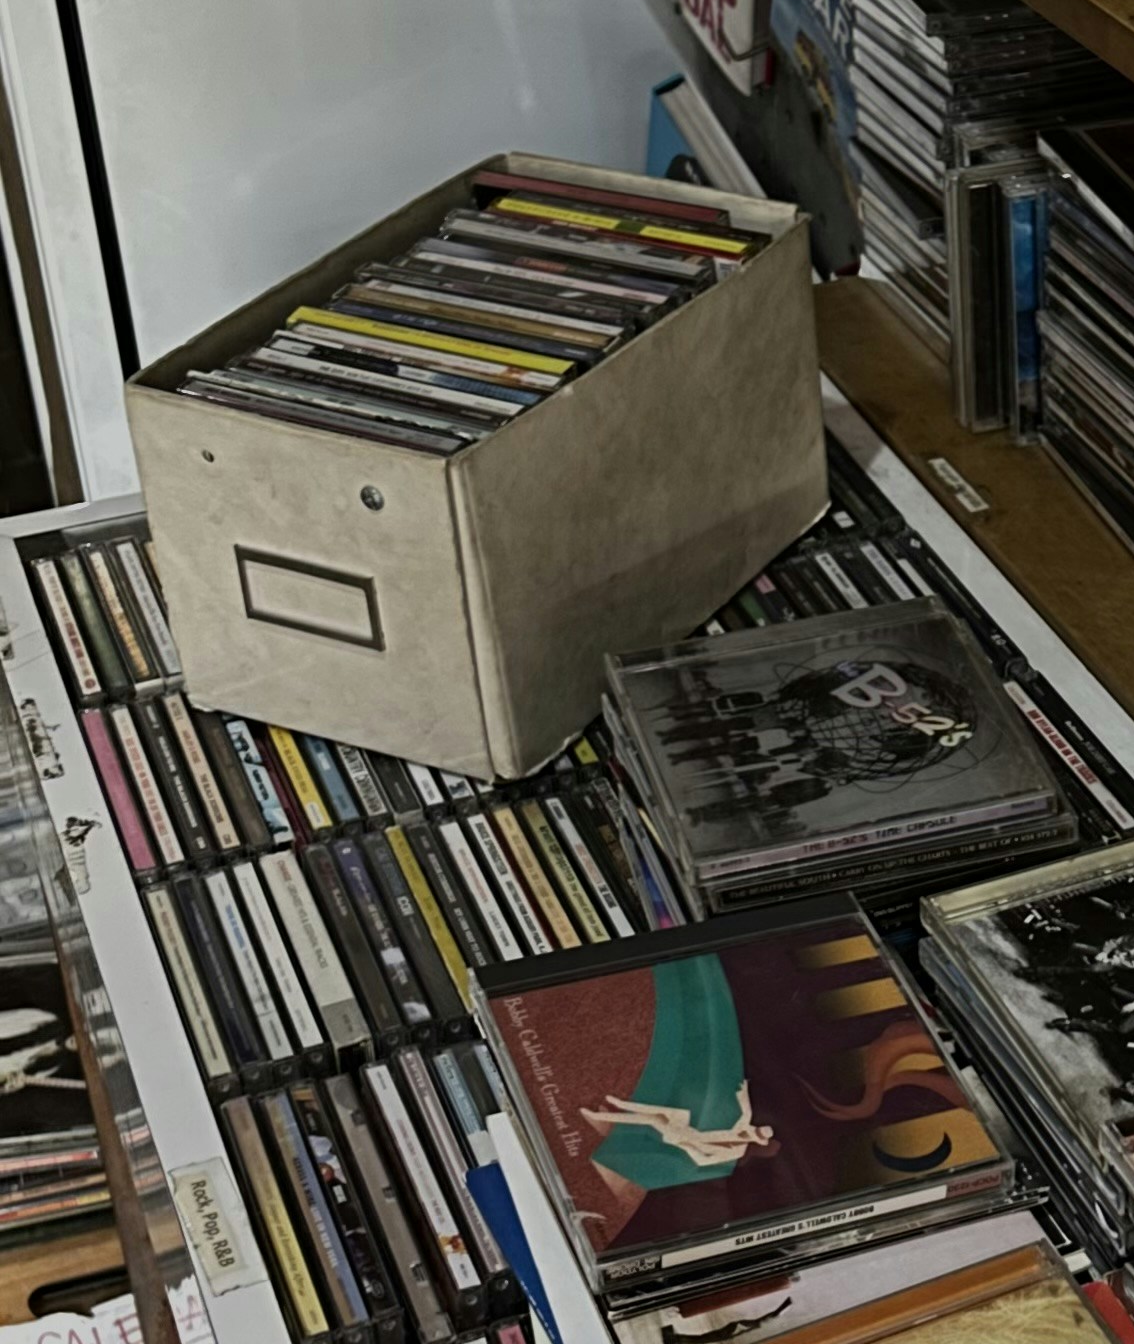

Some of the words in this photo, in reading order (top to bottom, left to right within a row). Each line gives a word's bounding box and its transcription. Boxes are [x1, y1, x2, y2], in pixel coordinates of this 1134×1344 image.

[834, 661, 973, 750] B-52's
[500, 993, 532, 1030] Bobby
[514, 1025, 554, 1084] Caldwell's
[538, 1080, 575, 1133] Greatest
[559, 1126, 587, 1159] Hits
[188, 1177, 212, 1215] Rock,
[200, 1209, 222, 1243] Pop,
[209, 1237, 236, 1270] R&B
